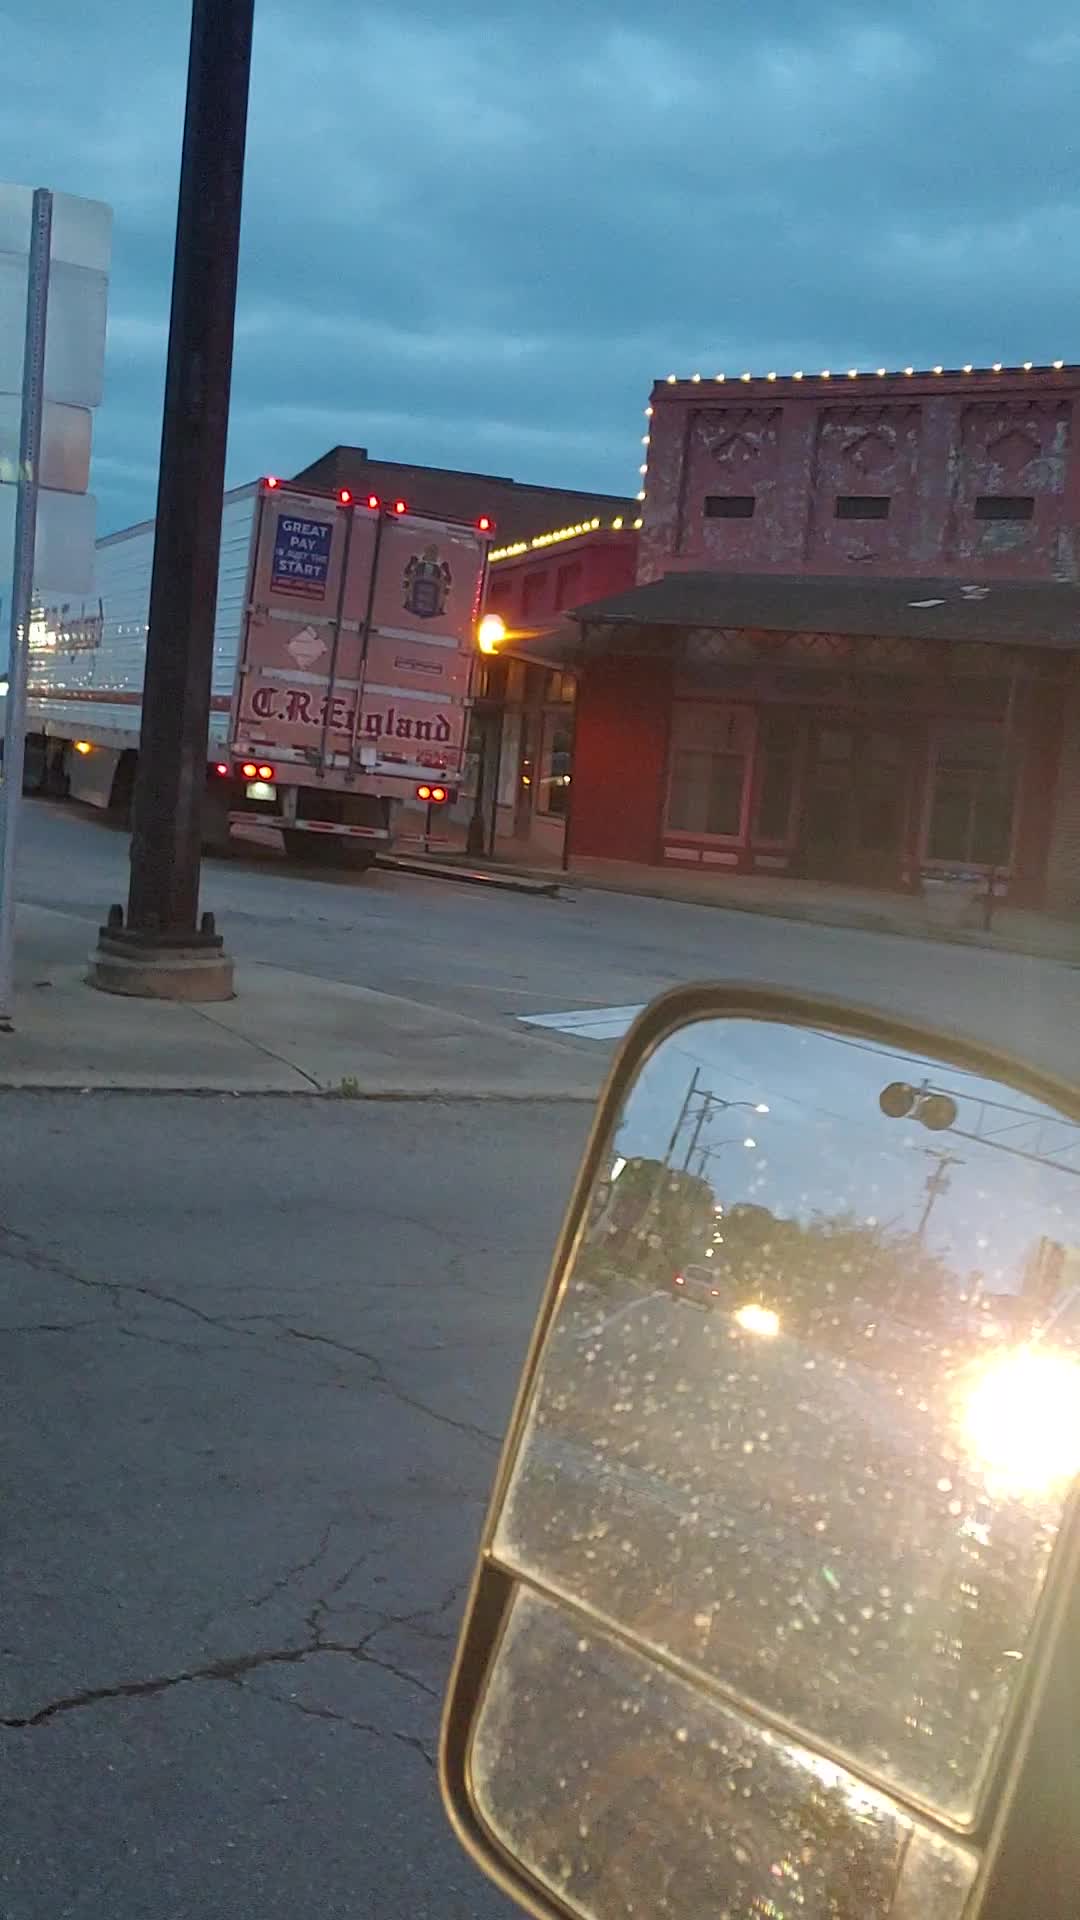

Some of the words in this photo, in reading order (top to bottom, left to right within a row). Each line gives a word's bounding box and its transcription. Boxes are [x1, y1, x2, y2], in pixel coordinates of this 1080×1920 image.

[282, 520, 328, 537] GREAT
[290, 536, 316, 550] PAY
[279, 560, 322, 577] START
